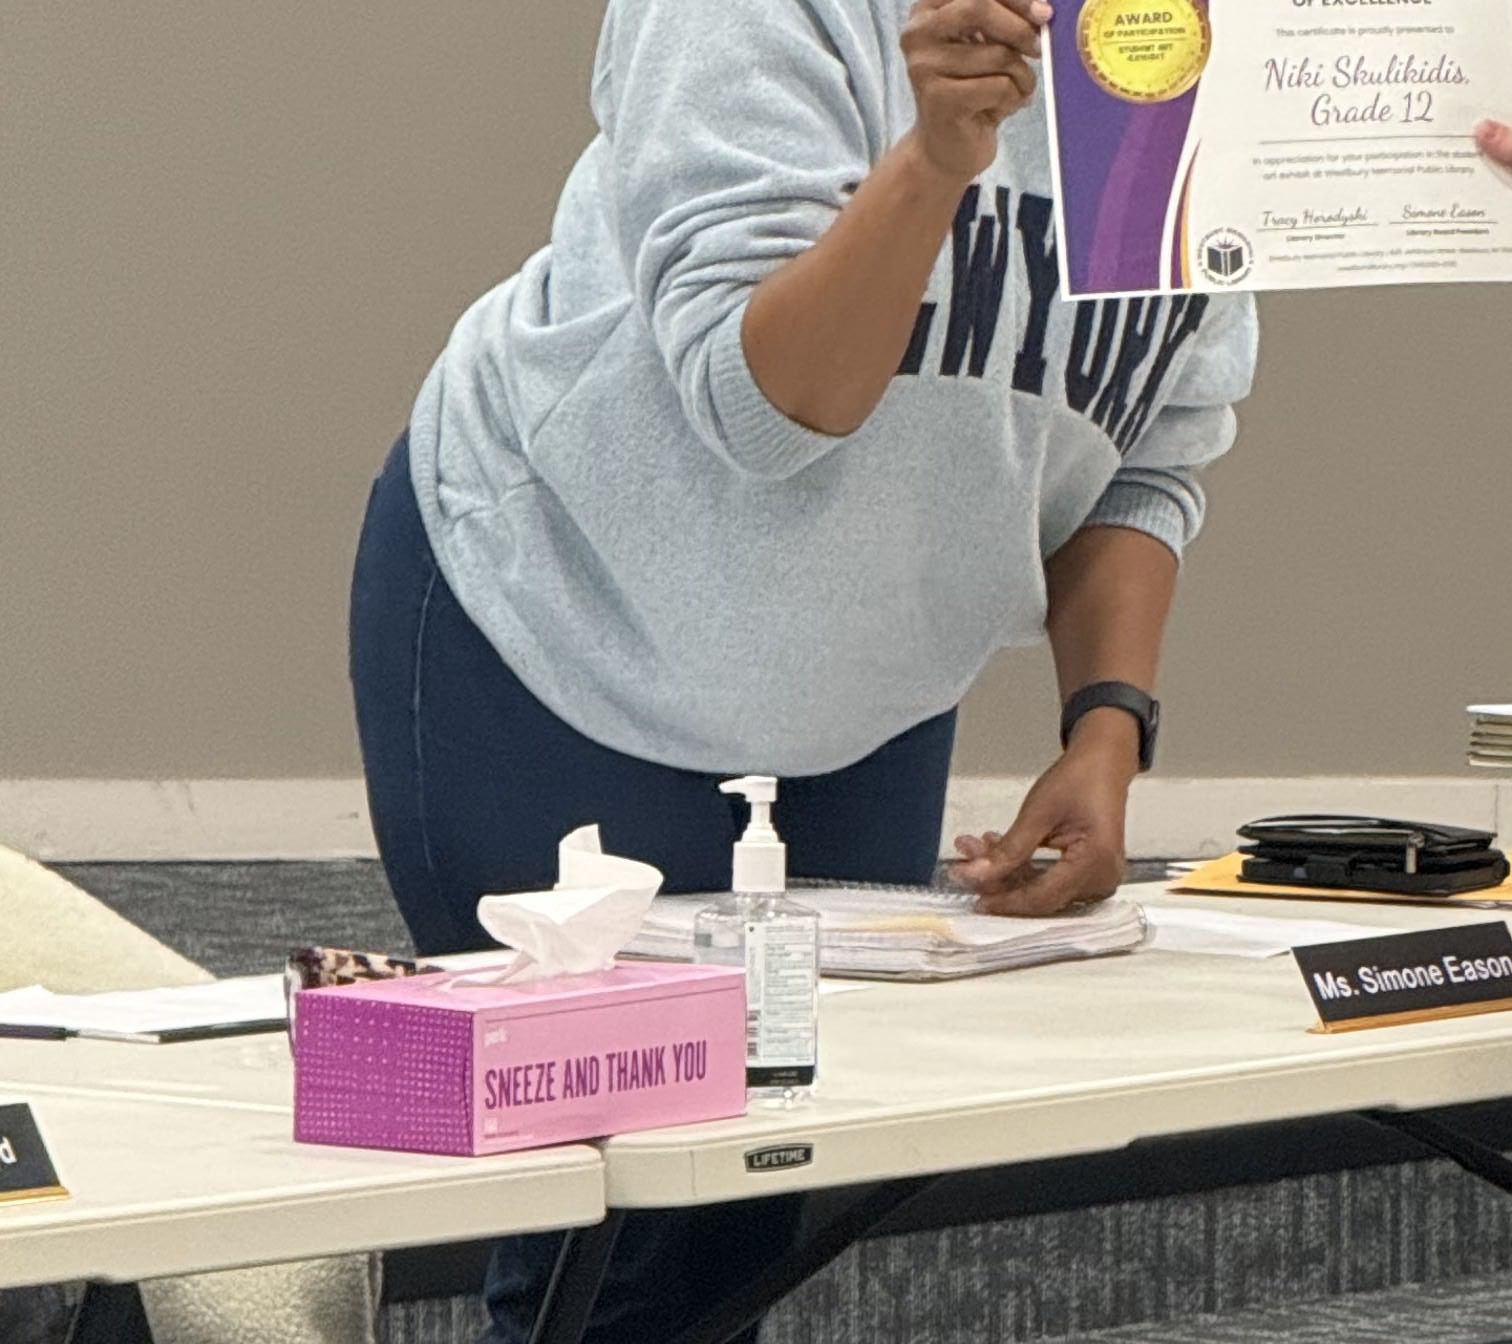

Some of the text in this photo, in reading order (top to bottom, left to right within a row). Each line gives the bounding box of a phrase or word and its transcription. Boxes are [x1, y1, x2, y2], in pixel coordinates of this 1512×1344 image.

[1115, 12, 1173, 26] AWARD
[1264, 57, 1325, 92] Niki
[1310, 90, 1435, 126] Grade 12
[1313, 971, 1360, 1000] Ms.
[1357, 964, 1444, 994] Simone
[484, 1039, 708, 1110] SNEEZE AND THANK YOU
[753, 1148, 806, 1167] LIFETIME
